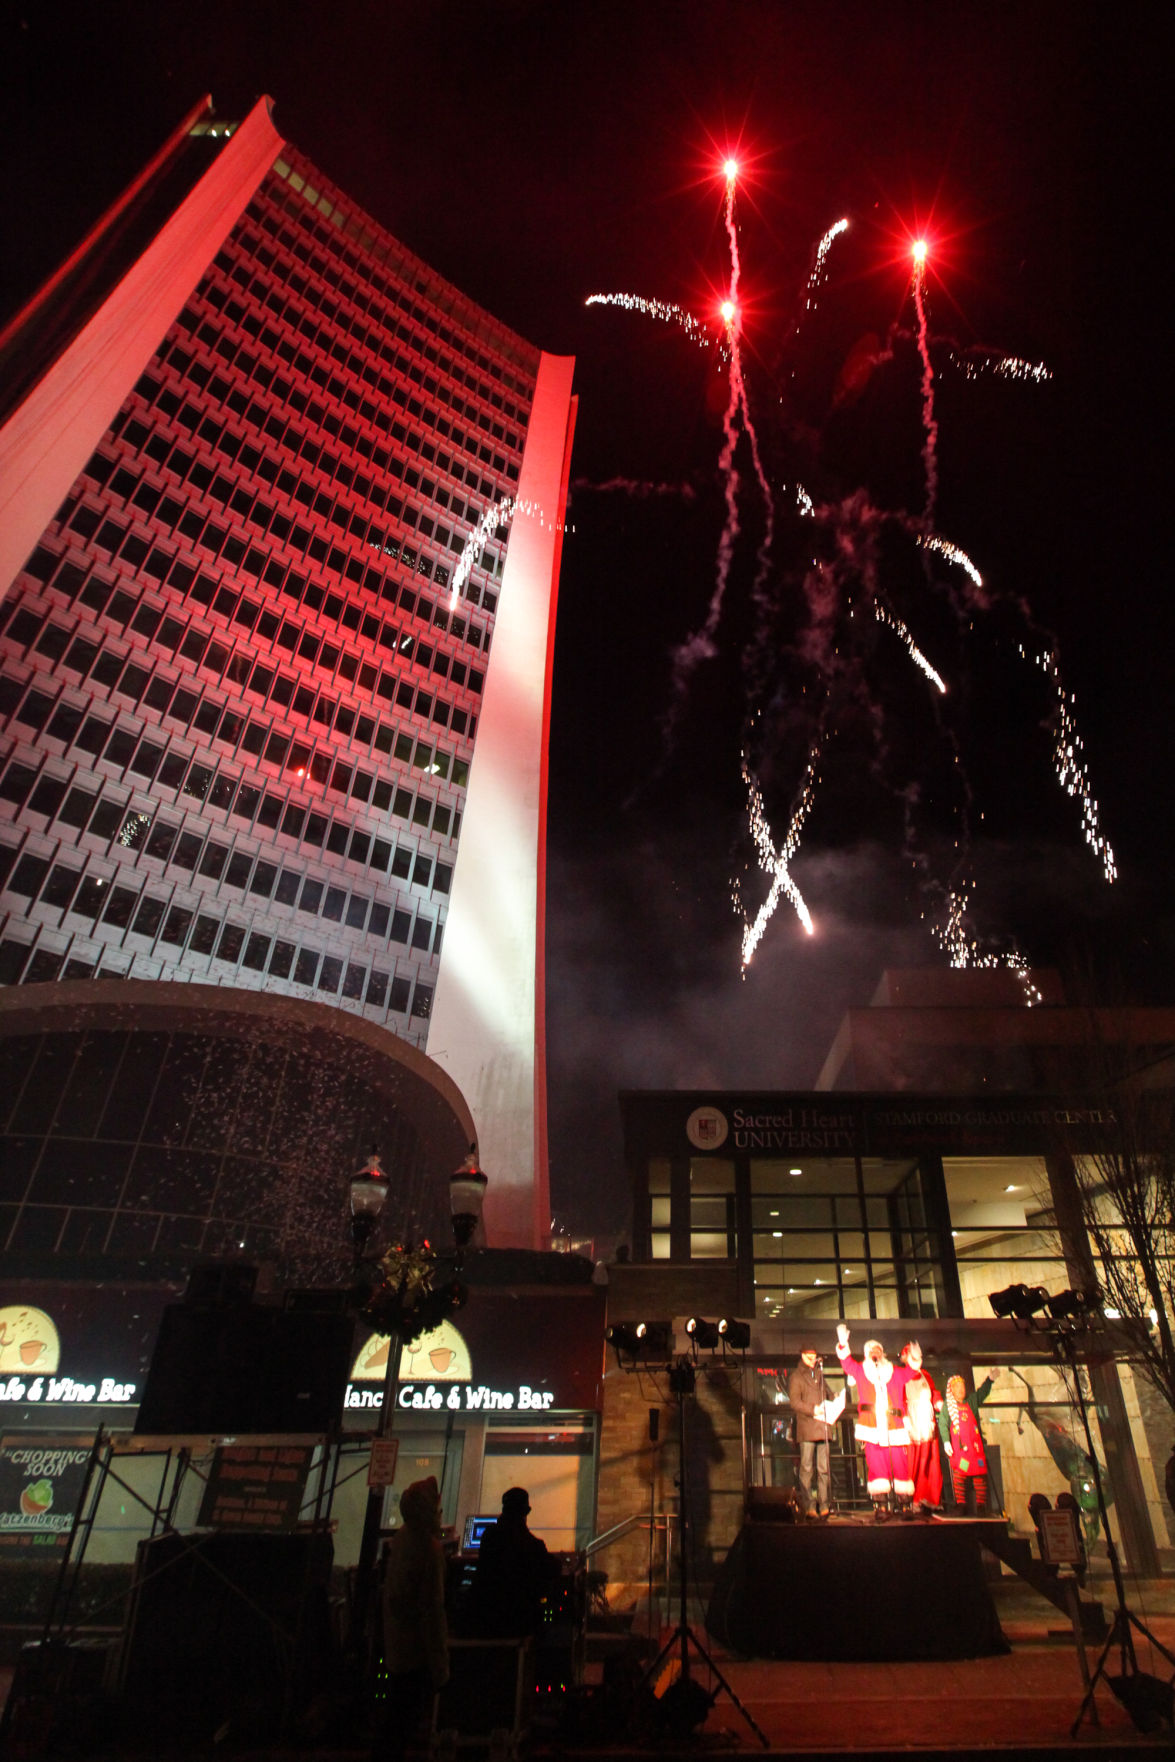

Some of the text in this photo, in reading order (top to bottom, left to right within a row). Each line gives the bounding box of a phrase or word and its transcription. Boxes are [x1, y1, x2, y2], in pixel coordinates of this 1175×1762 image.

[733, 1108, 856, 1129] Sacred Heart
[875, 1110, 961, 1126] STAMFORD
[733, 1131, 858, 1149] UNIVERSITY
[46, 1377, 96, 1401] Wine
[97, 1378, 136, 1402] Bar
[399, 1384, 443, 1409] Cafe
[447, 1385, 460, 1409] &
[466, 1385, 514, 1410] Wine
[518, 1385, 554, 1410] Bar
[24, 1462, 67, 1477] SOON
